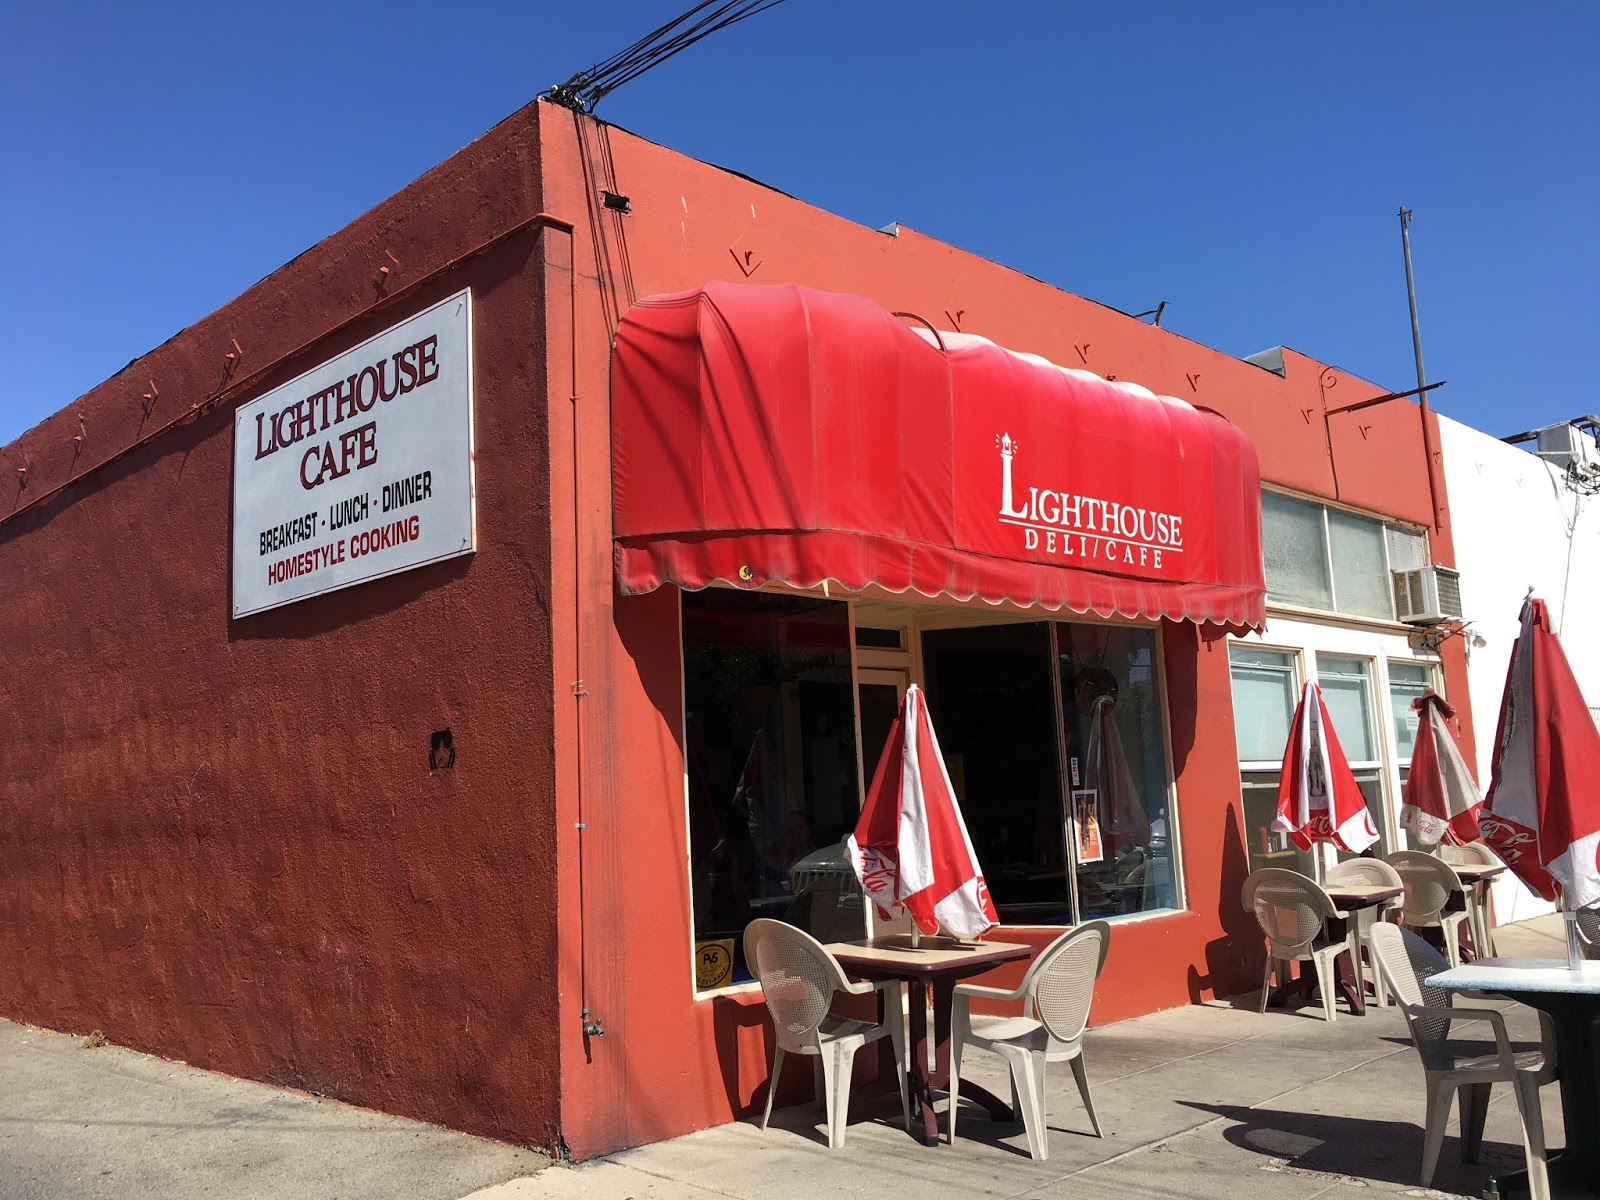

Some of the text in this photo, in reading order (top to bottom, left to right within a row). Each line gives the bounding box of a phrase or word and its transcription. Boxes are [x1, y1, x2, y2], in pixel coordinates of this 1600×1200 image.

[255, 334, 439, 460] LIGHTHOUSE
[299, 421, 378, 490] CAFE
[998, 434, 1184, 546] LIGHTHOUSE
[259, 470, 432, 556] BREAKFAST LUNCH DINNER
[268, 515, 420, 586] HOMESTYLE COOKING
